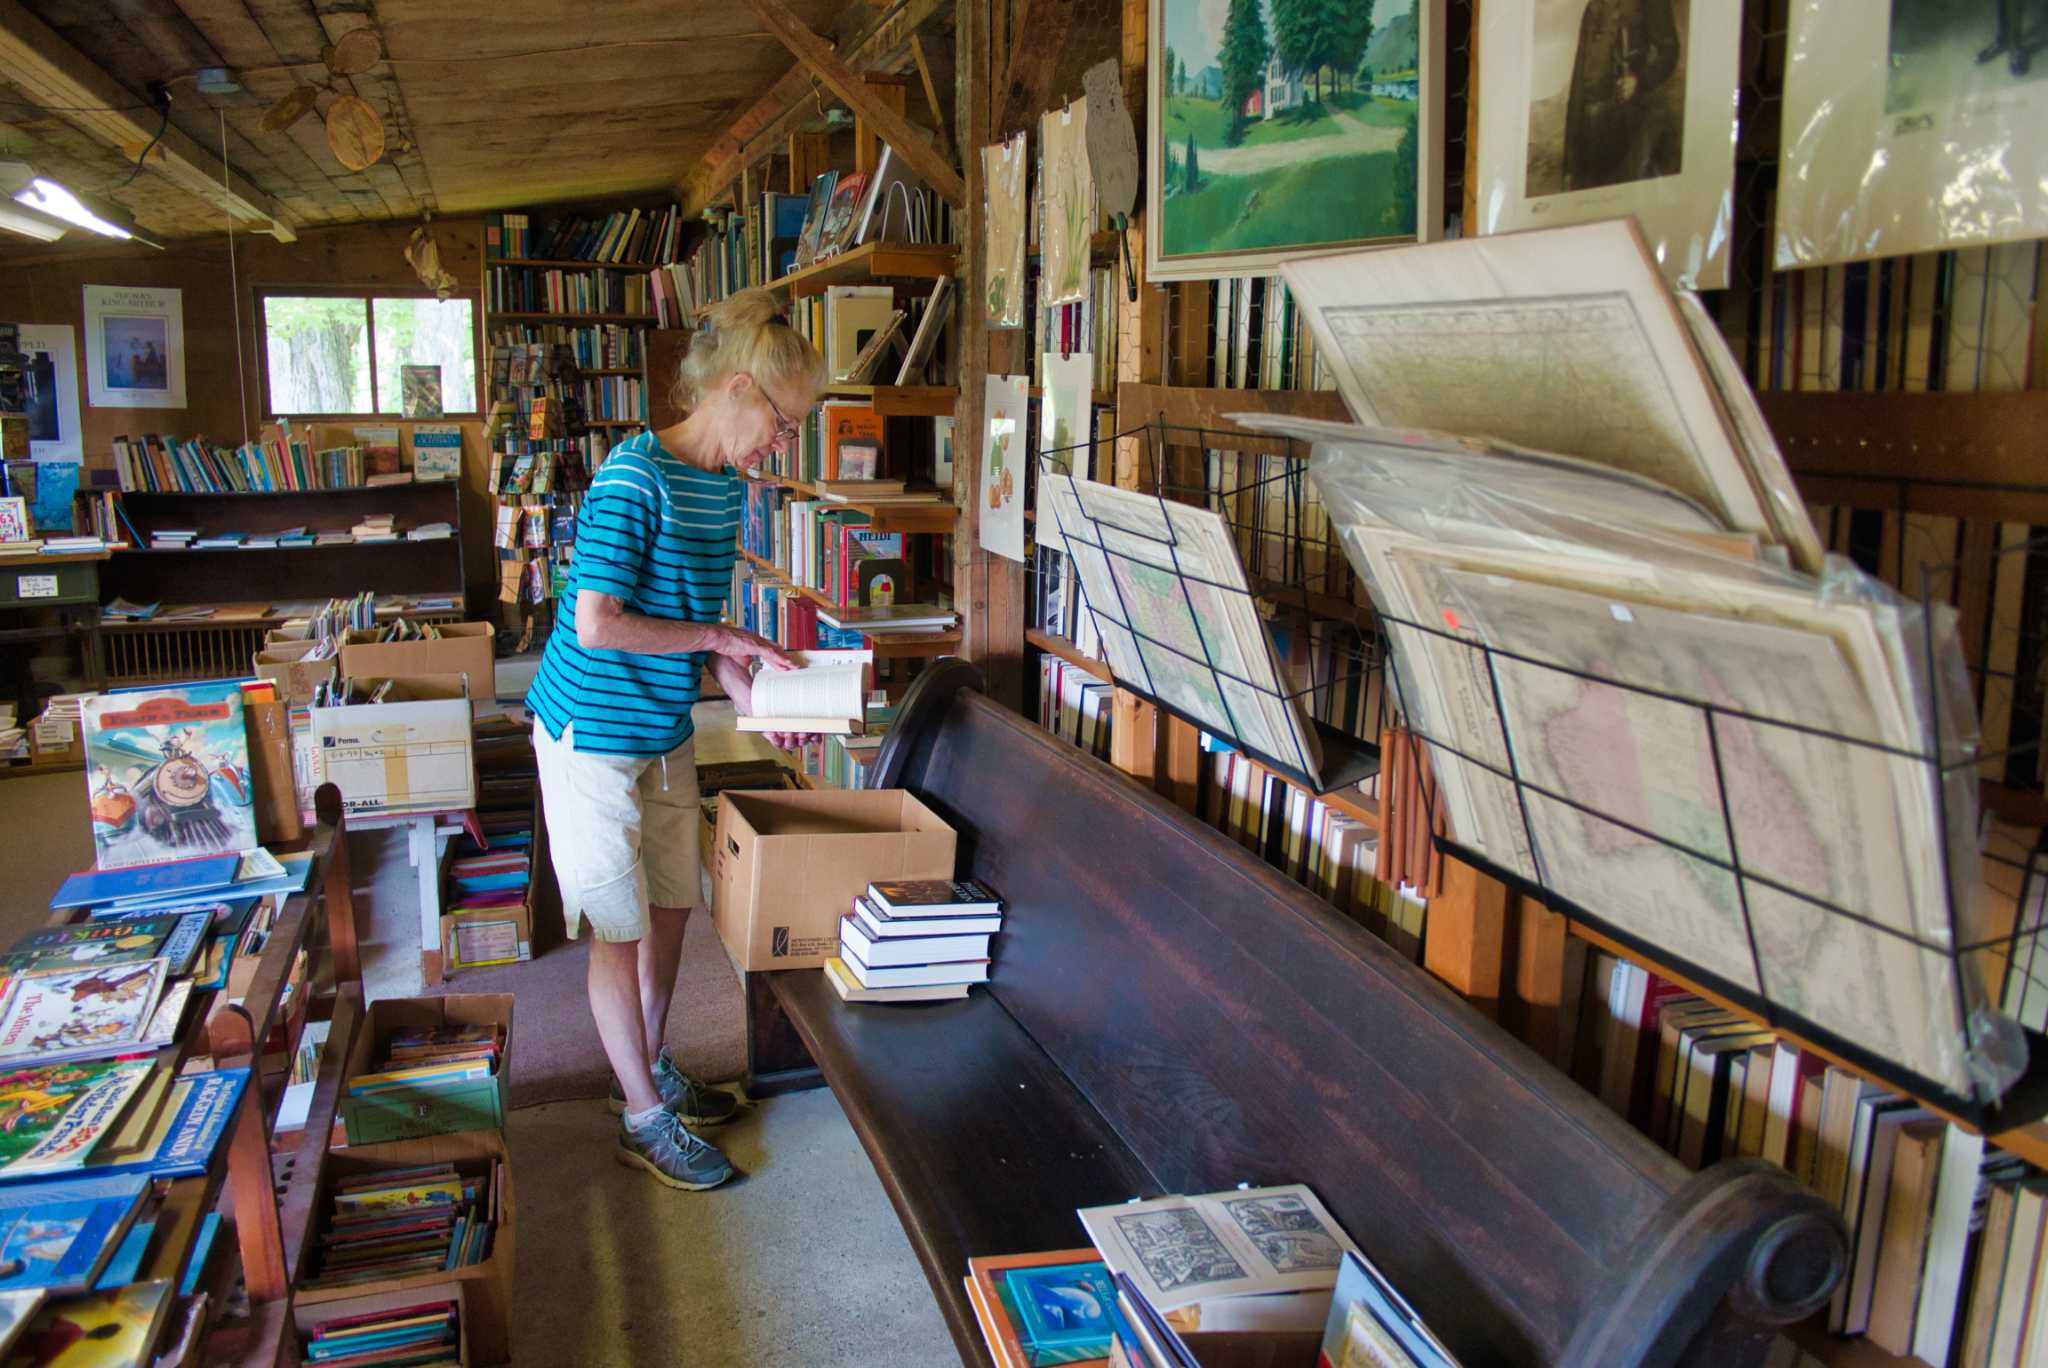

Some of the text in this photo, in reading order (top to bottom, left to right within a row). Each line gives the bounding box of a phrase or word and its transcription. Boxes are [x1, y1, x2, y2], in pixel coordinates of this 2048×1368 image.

[859, 532, 891, 541] HEIDI
[4, 995, 43, 1045] The Mitten
